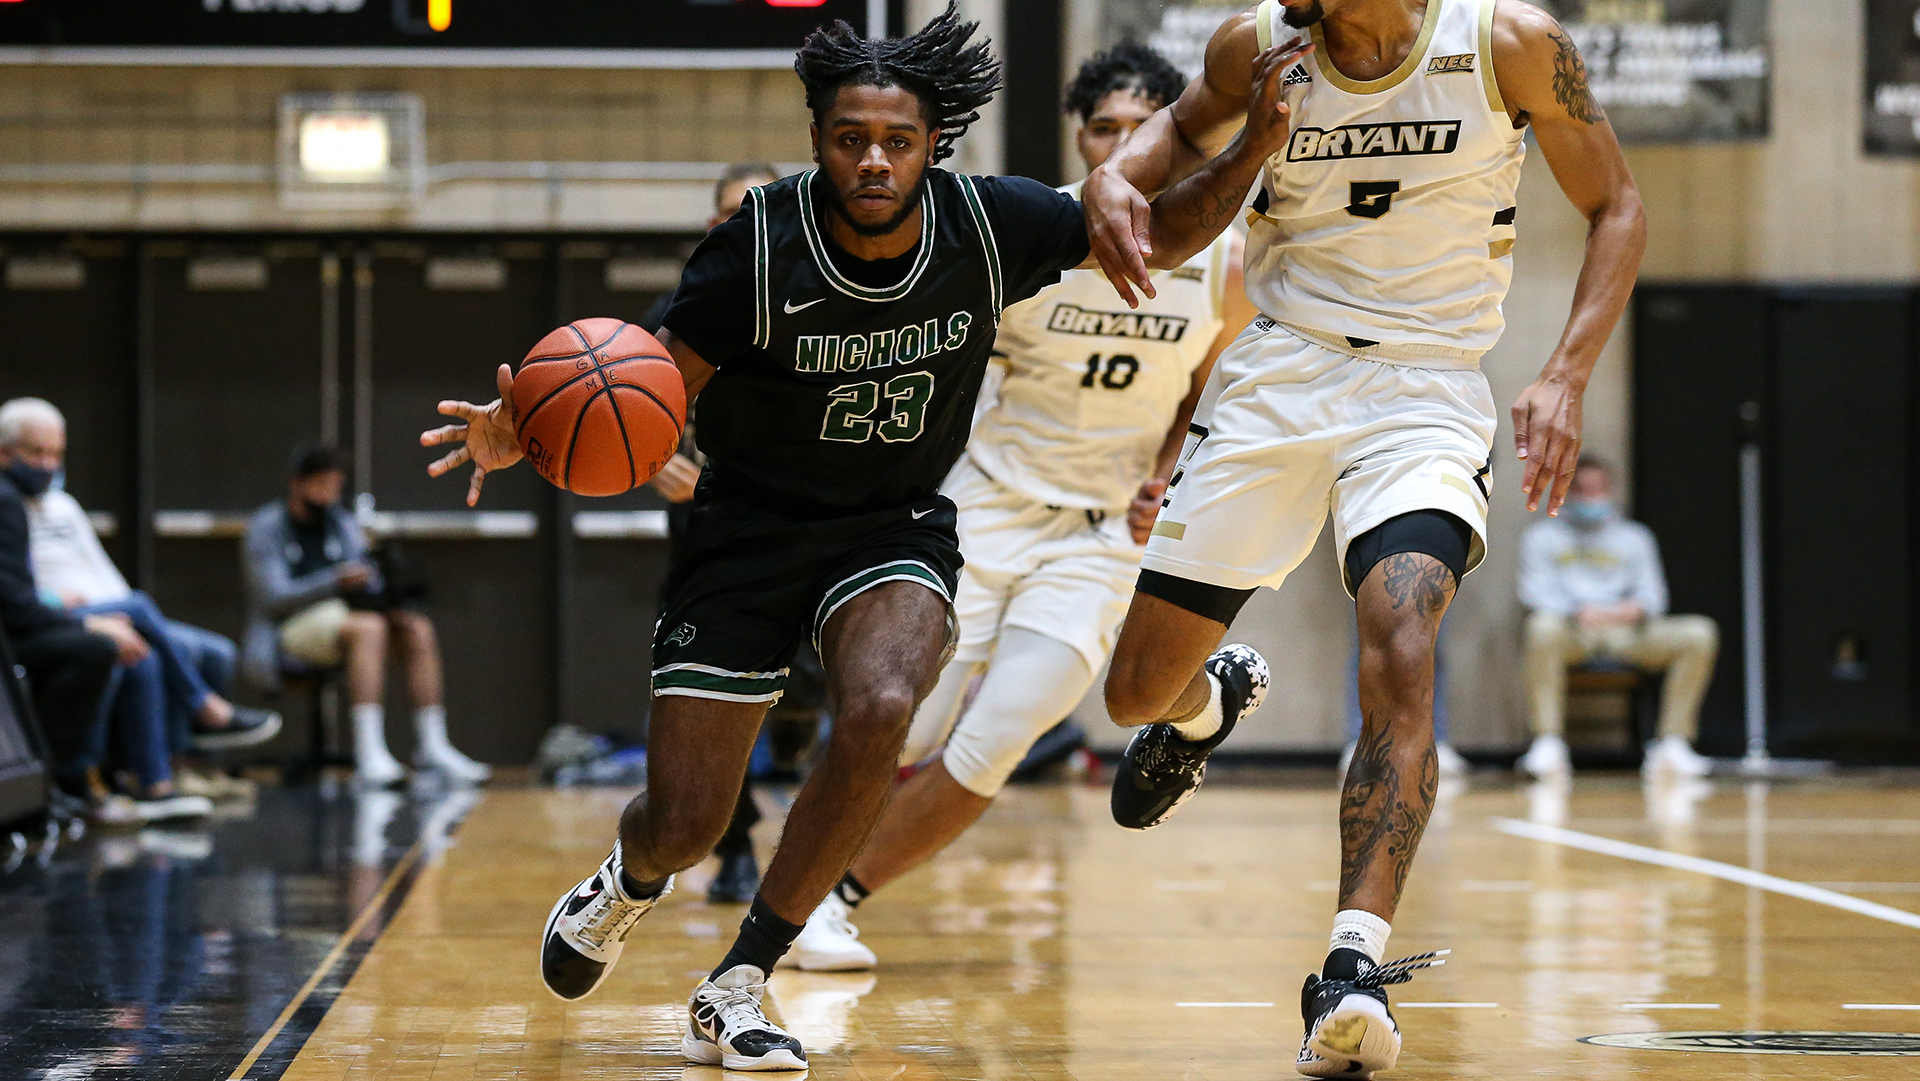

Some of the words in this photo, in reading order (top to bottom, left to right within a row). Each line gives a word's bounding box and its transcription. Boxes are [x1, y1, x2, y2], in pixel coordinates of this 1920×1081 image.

[1283, 75, 1312, 86] adidas
[1428, 53, 1476, 71] NEC
[1288, 122, 1460, 162] BRYANT
[1344, 179, 1401, 221] 5
[795, 310, 972, 372] NICHOLS
[1049, 304, 1188, 342] BRYANT
[1080, 353, 1140, 390] 10
[819, 370, 935, 443] 23
[1338, 934, 1365, 942] adidas
